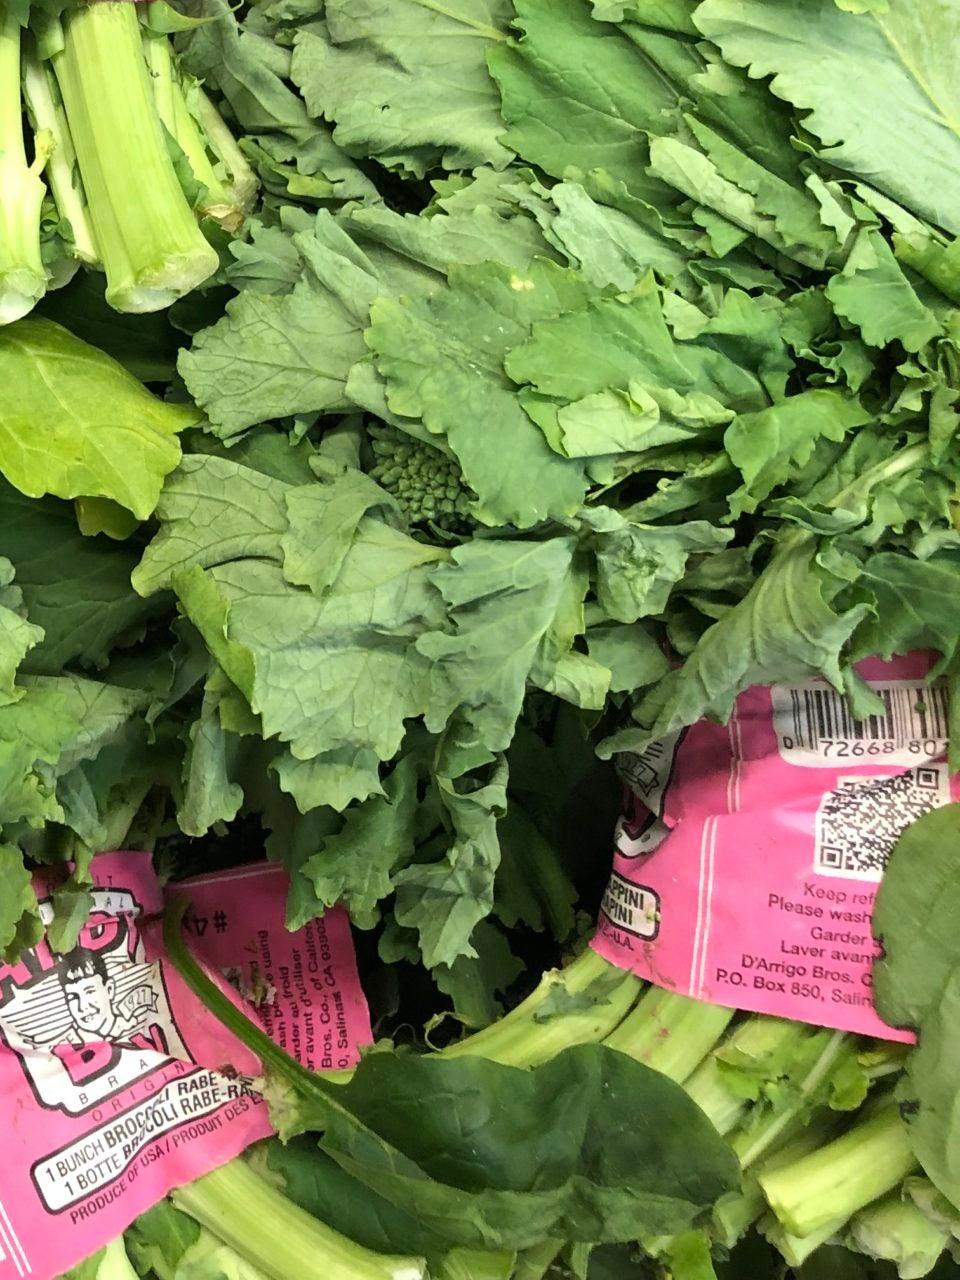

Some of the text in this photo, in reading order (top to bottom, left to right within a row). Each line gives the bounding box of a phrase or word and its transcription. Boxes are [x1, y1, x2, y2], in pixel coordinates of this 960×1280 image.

[820, 739, 895, 757] 72668
[768, 893, 824, 919] Please
[804, 882, 847, 904] Keep
[781, 940, 826, 958] Laver
[810, 926, 868, 946] Garder
[278, 966, 294, 1000] froid
[324, 965, 336, 987] CA
[715, 967, 874, 1008] P.O. Box 850, Salin
[741, 953, 855, 984] D'Arrigo Bros.
[257, 930, 288, 1048] ash using
[291, 1024, 302, 1063] arder
[303, 1011, 315, 1054] avant
[321, 1029, 332, 1068] Bros.
[92, 1061, 186, 1122] ORIGIN
[46, 1167, 56, 1182] 1
[55, 1139, 105, 1178] BUNCH
[64, 1181, 74, 1196] 1
[76, 1153, 122, 1190] BOTTE
[69, 1179, 128, 1225] PRODUCE
[127, 1163, 141, 1183] OF
[140, 1144, 165, 1168] USA
[171, 1115, 224, 1149] PRODUIT
[224, 1098, 250, 1122] DES
